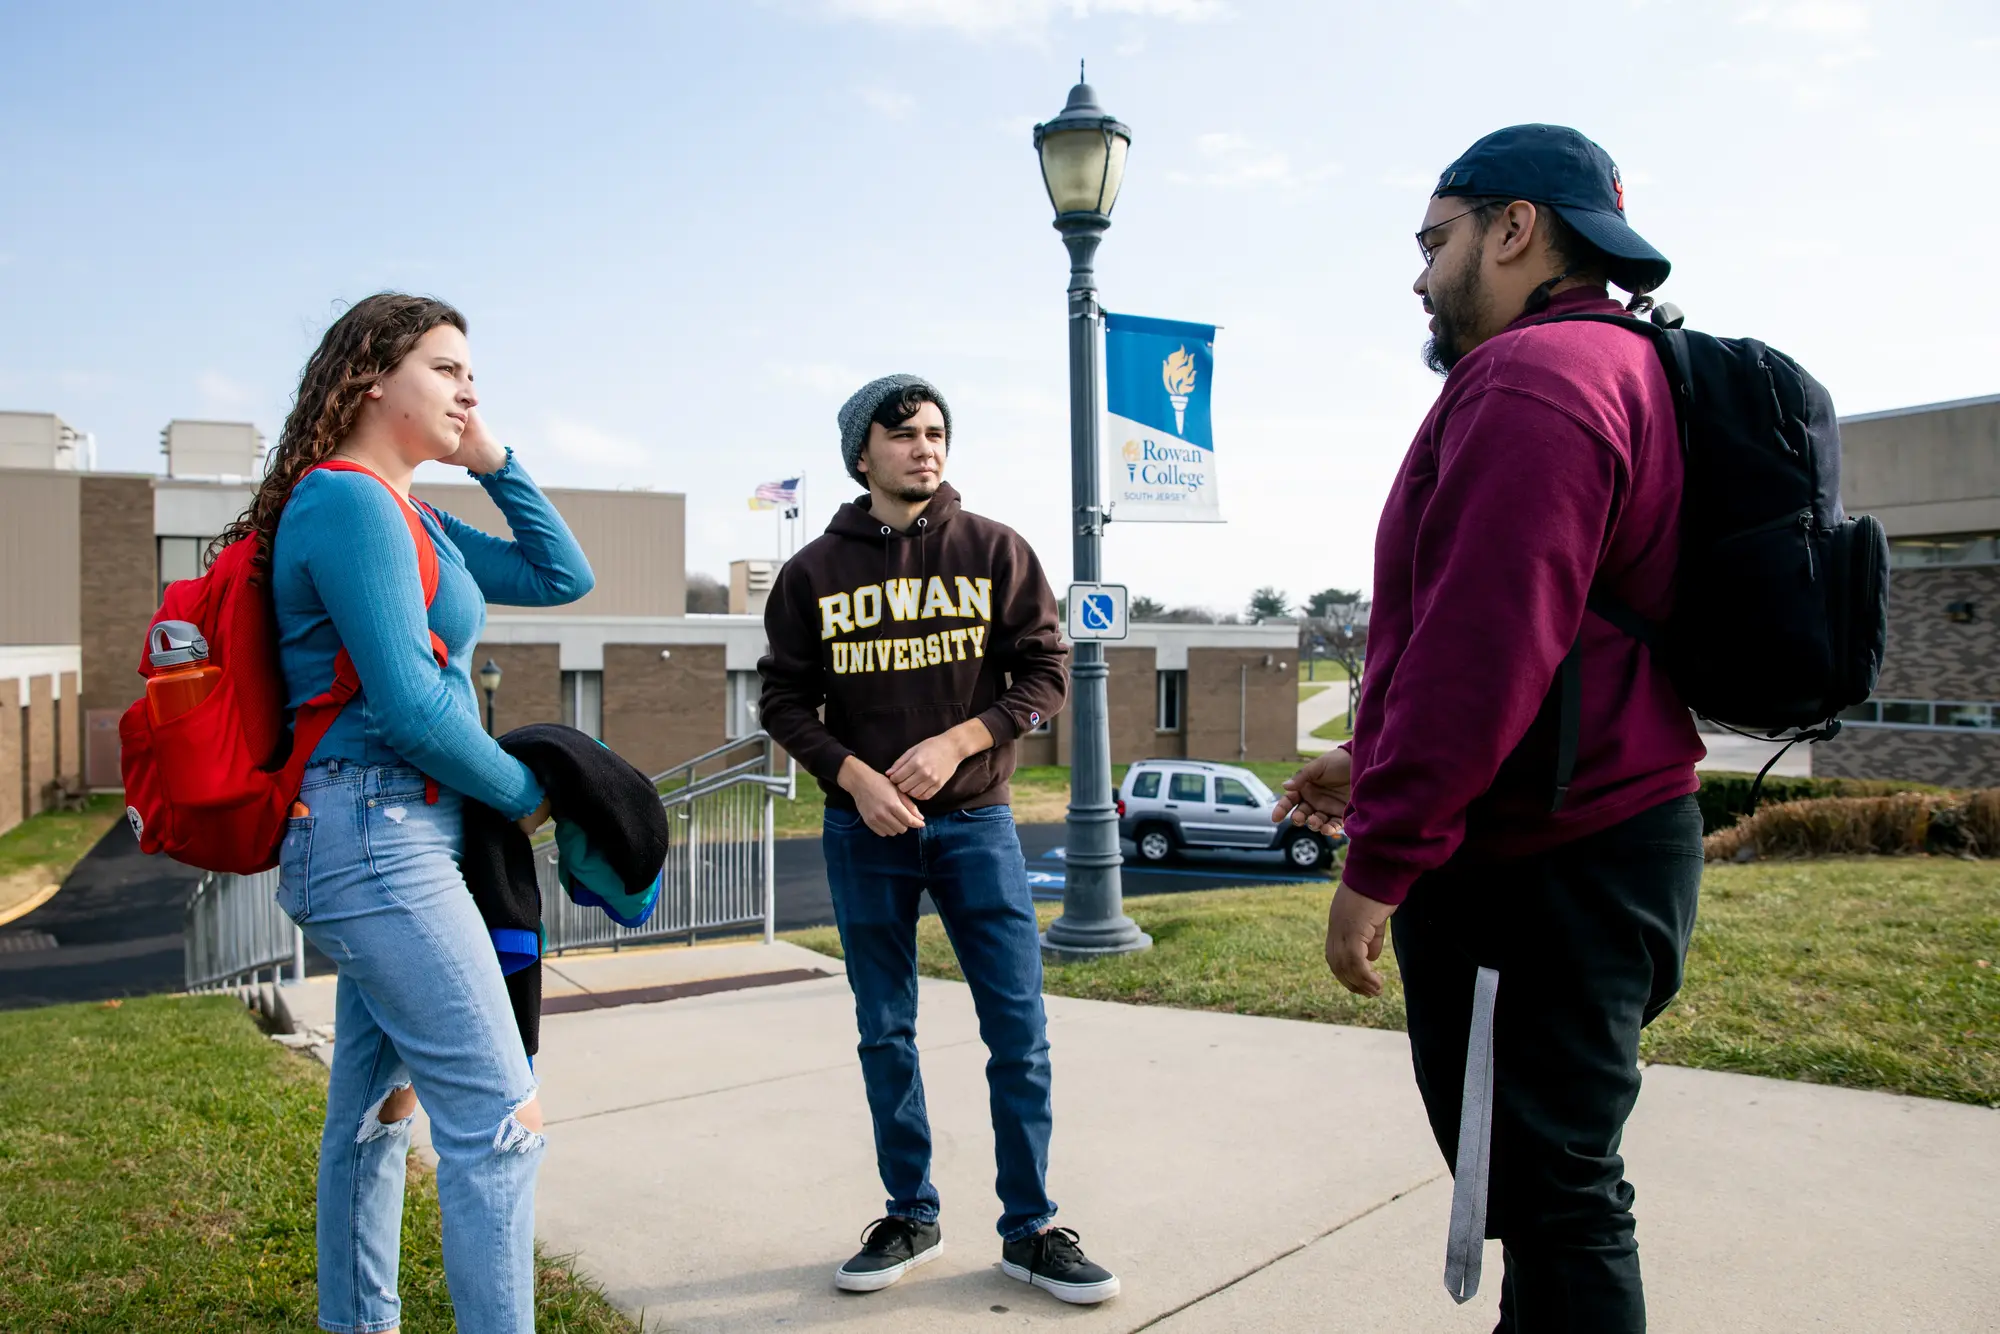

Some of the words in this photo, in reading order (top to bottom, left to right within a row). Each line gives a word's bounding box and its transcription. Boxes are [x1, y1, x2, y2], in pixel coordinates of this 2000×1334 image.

[1143, 439, 1202, 463] Rowan
[1142, 464, 1205, 493] College
[1124, 491, 1153, 500] SOUTH
[1155, 492, 1186, 501] JERSEY
[818, 575, 992, 640] ROWAN
[832, 625, 985, 674] UNIVERSITY
